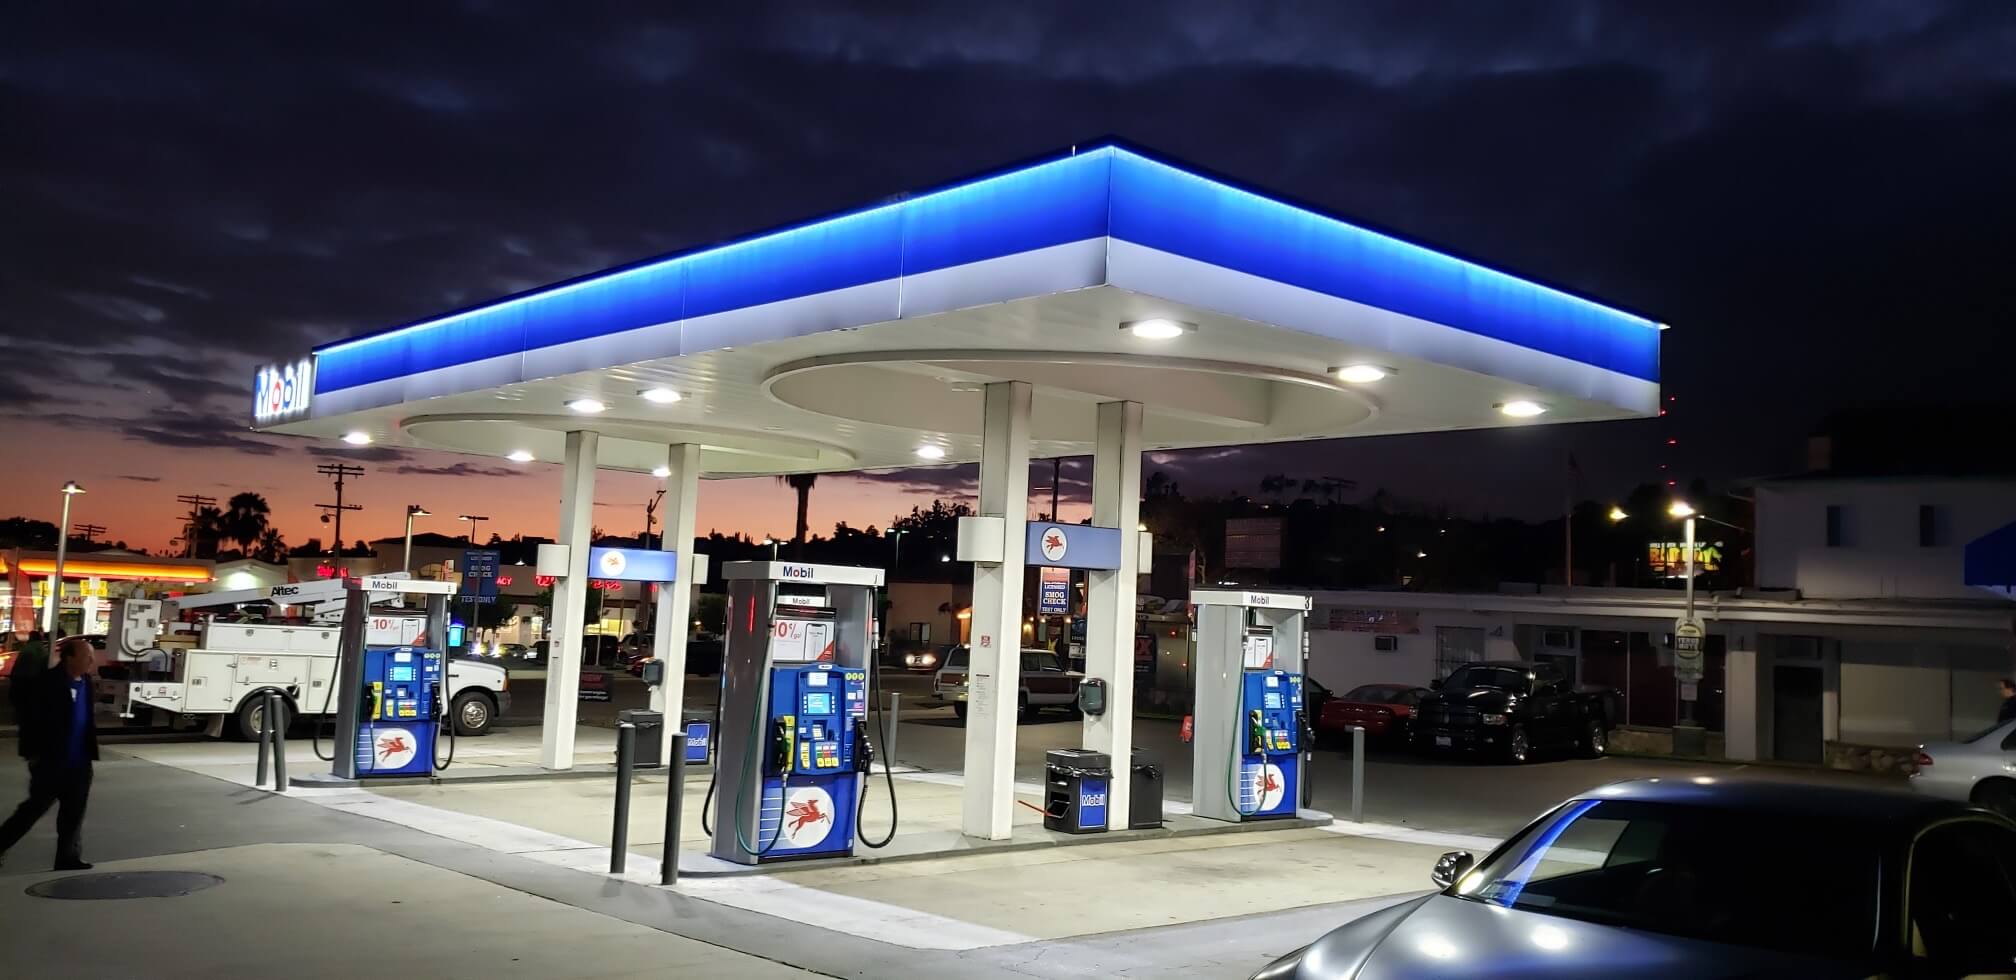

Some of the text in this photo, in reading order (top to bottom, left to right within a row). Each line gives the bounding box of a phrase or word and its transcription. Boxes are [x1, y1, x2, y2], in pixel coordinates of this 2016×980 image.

[255, 361, 311, 417] Mobil
[782, 565, 814, 579] Mobil
[372, 580, 398, 590] Mobil
[271, 586, 299, 597] Altec
[1250, 594, 1270, 605] Mobil
[1081, 793, 1105, 807] Mobil
